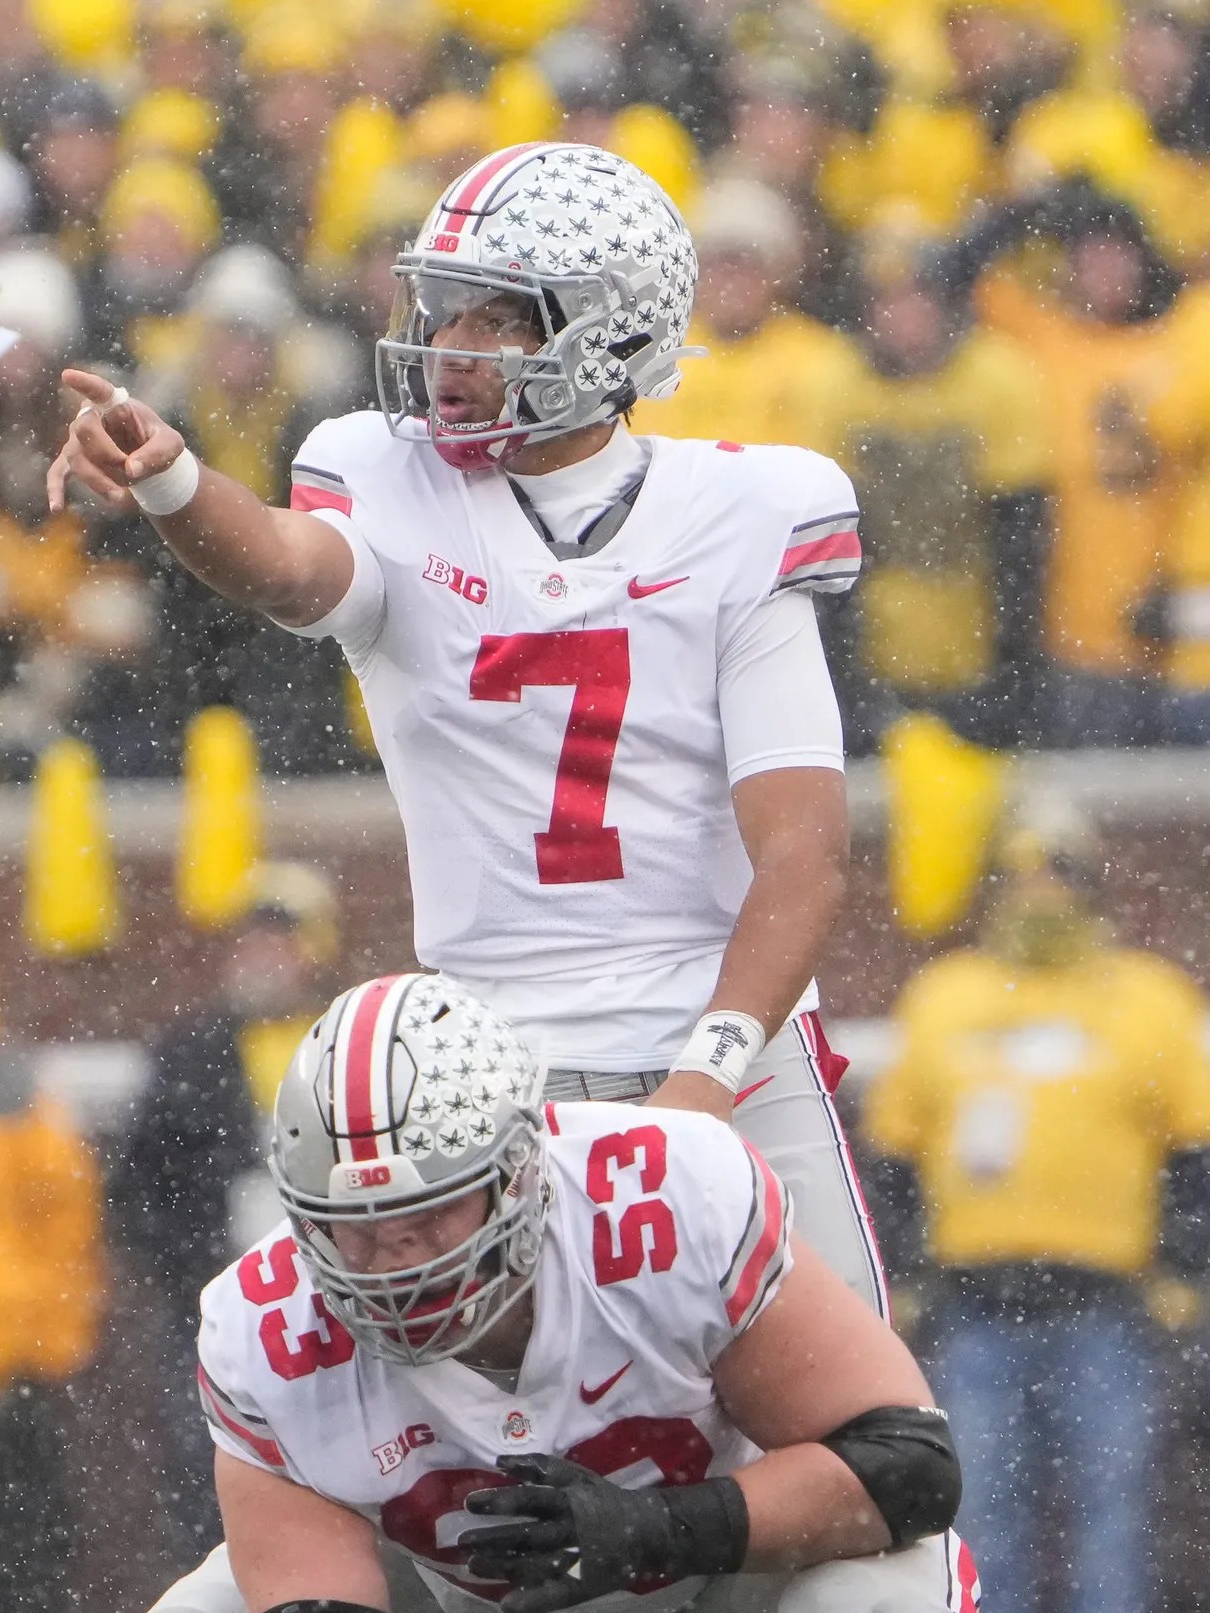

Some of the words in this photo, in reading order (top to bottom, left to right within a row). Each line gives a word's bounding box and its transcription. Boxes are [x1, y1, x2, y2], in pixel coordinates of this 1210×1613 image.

[469, 627, 631, 884] 7
[587, 1124, 678, 1287] 53
[236, 1235, 356, 1381] 53
